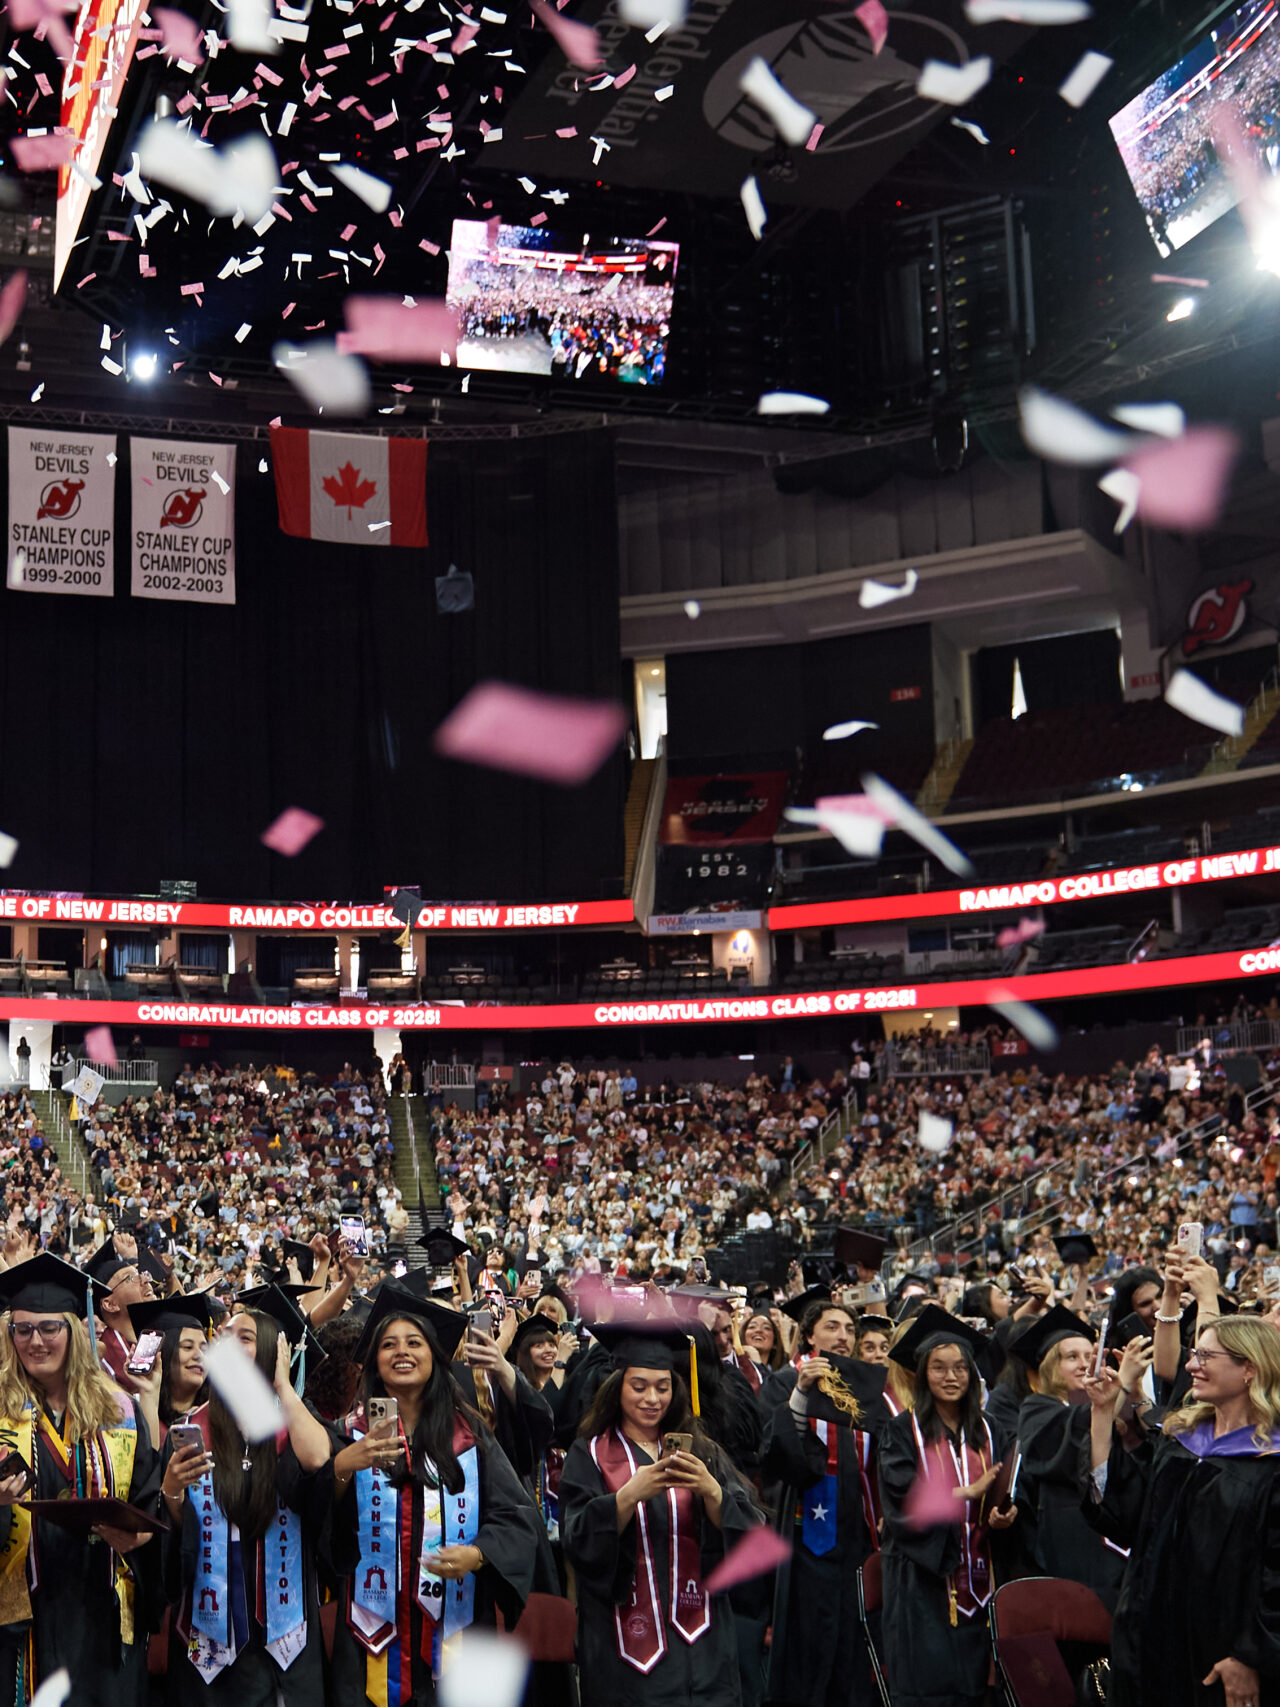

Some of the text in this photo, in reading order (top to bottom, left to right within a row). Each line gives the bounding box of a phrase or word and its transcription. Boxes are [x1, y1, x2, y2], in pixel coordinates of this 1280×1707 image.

[588, 0, 734, 148] rudential
[30, 441, 94, 456] NEW JERSEY
[152, 451, 215, 465] NEW JERSEY
[35, 456, 89, 475] DEVILS
[156, 465, 209, 484] DEVILS
[12, 523, 111, 547] STANLEY CUP
[136, 531, 232, 556] STANLEY CUP
[16, 545, 106, 568] CHAMPIONS
[140, 553, 227, 576] CHAMPIONS
[22, 568, 101, 585] 1999-2000
[143, 575, 224, 593] 2002-2003
[685, 864, 748, 878] 1982
[959, 881, 1056, 911] RAMAPO
[1059, 866, 1161, 899] COLLEGE
[1163, 861, 1197, 885] OF
[1201, 852, 1258, 880] NEW
[22, 899, 50, 918] OF
[56, 900, 105, 920] NEW
[109, 902, 183, 923] JERSEY
[229, 904, 579, 927] RAMAPO COLLEG OF NEW JERSEY
[138, 1005, 441, 1026] CONGRATULATIONS CLASS OF 2025!
[595, 989, 917, 1023] CONGRATULATIONS CLASS OF 2025!
[1002, 1042, 1017, 1054] 22
[494, 1068, 500, 1078] 1
[371, 1466, 381, 1553] EACHER
[203, 1472, 212, 1574] TEACHER
[279, 1498, 289, 1605] UCATION
